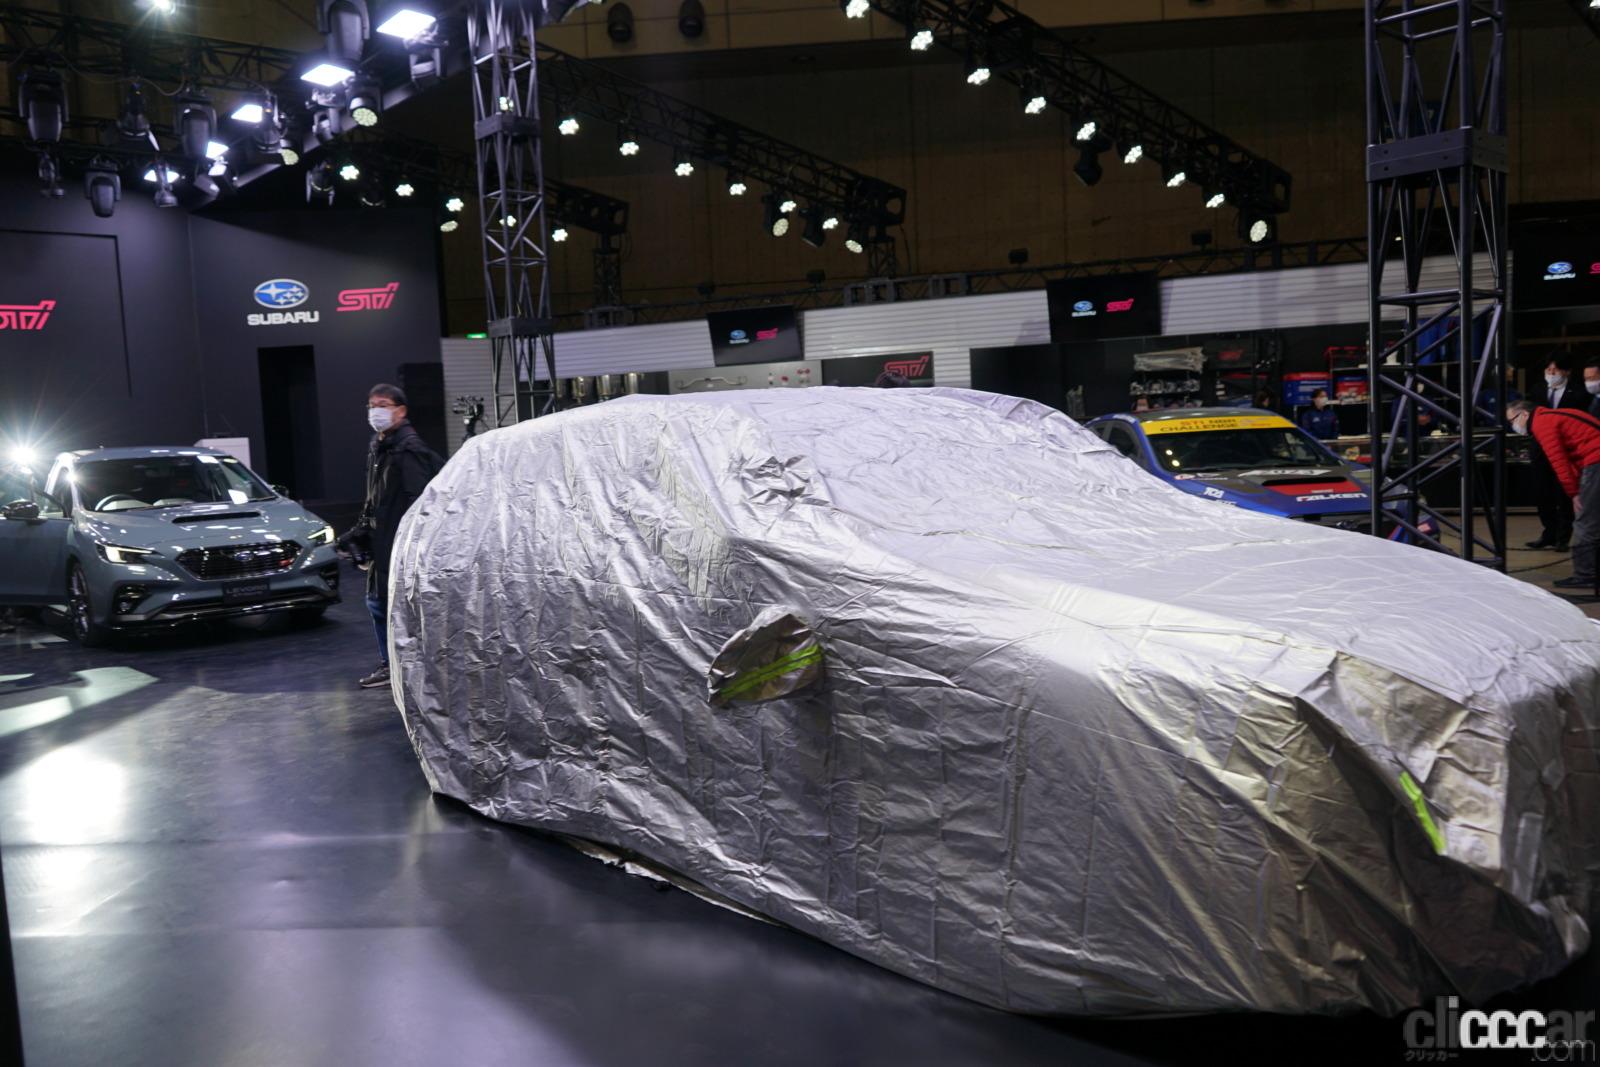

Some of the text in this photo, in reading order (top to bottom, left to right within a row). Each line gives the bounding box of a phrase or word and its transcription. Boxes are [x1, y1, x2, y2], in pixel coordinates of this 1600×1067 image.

[247, 310, 320, 326] SUBARU
[1160, 423, 1239, 433] CHALLENGE
[1295, 492, 1368, 503] FALKEN
